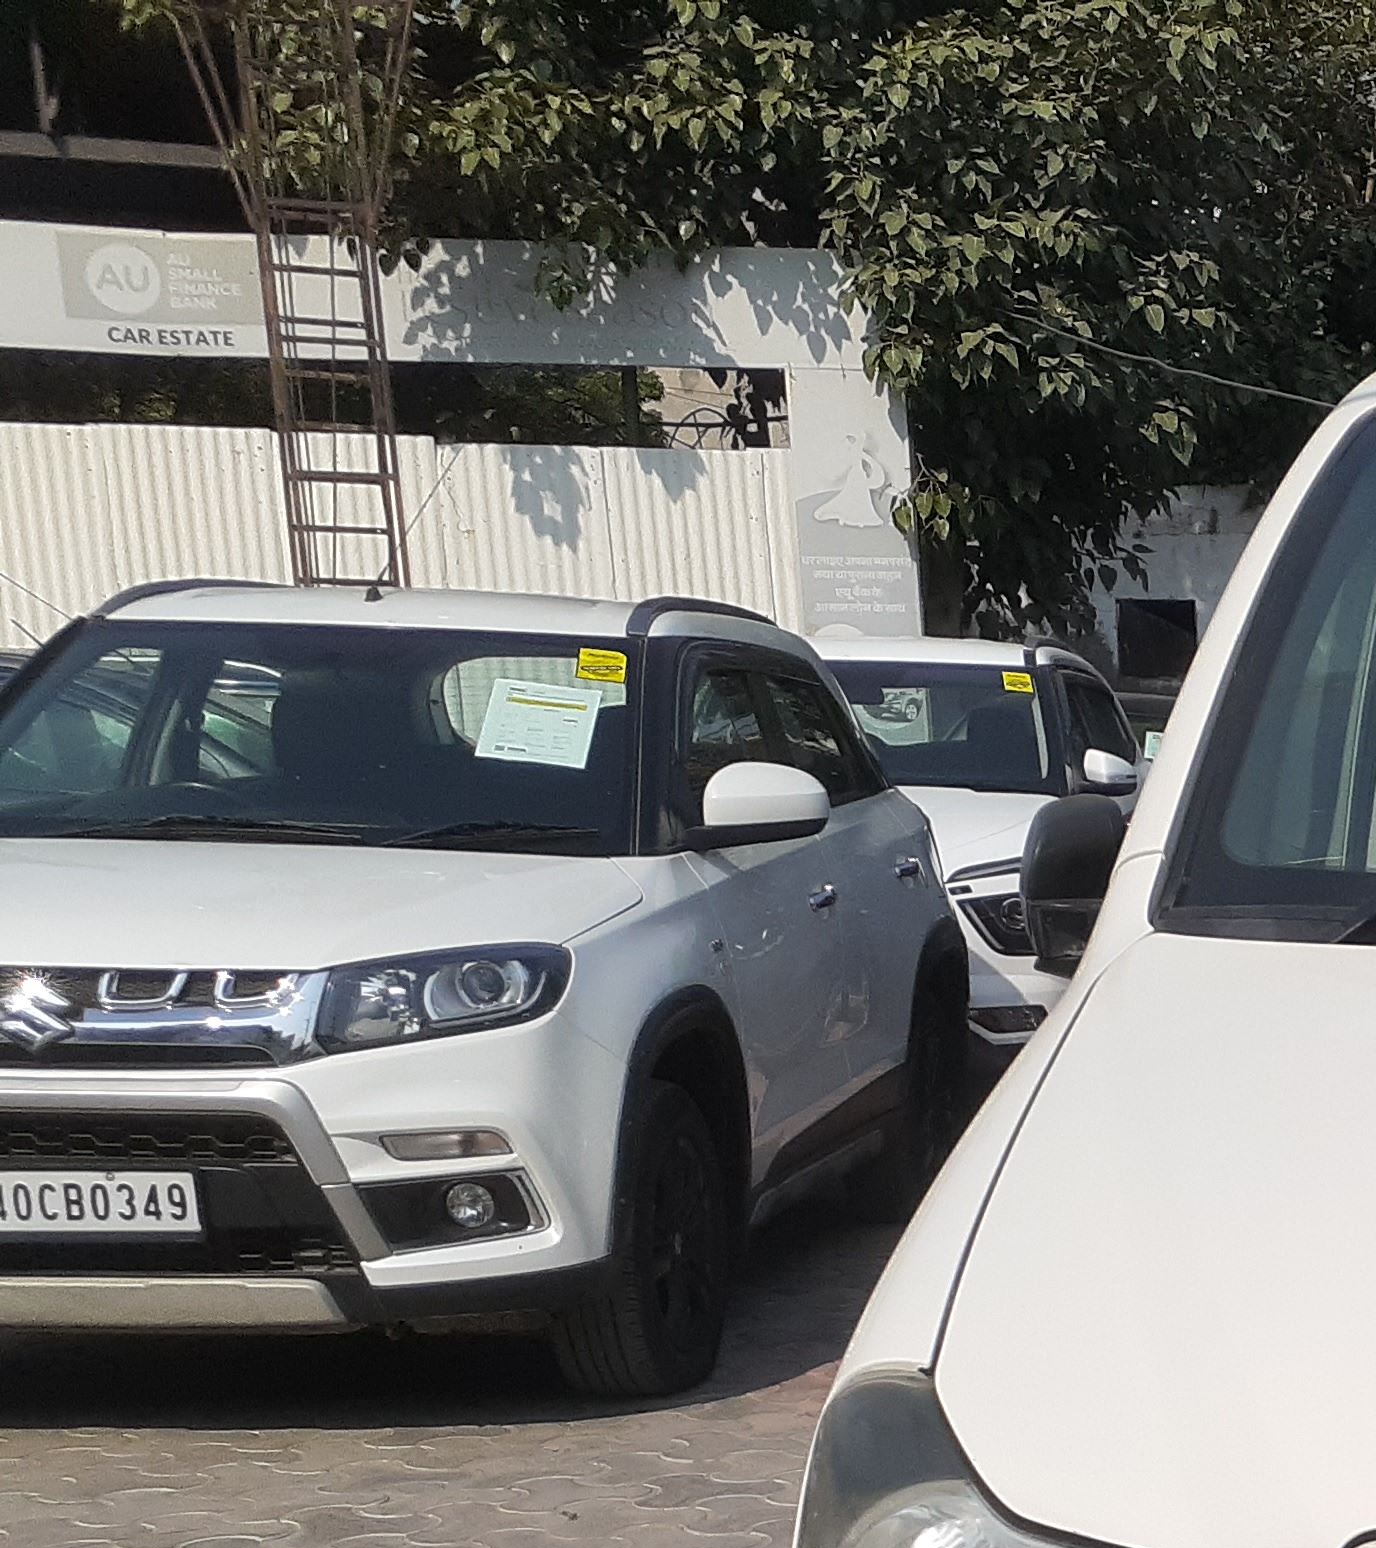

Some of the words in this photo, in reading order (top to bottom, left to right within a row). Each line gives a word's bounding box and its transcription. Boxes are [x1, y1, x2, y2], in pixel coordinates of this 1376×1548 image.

[167, 254, 190, 265] AU
[97, 263, 149, 292] AU
[169, 268, 222, 281] SMALL
[169, 283, 242, 296] FINANCE
[170, 296, 217, 309] BANK
[107, 326, 152, 344] CAR
[158, 330, 235, 346] ESTATE
